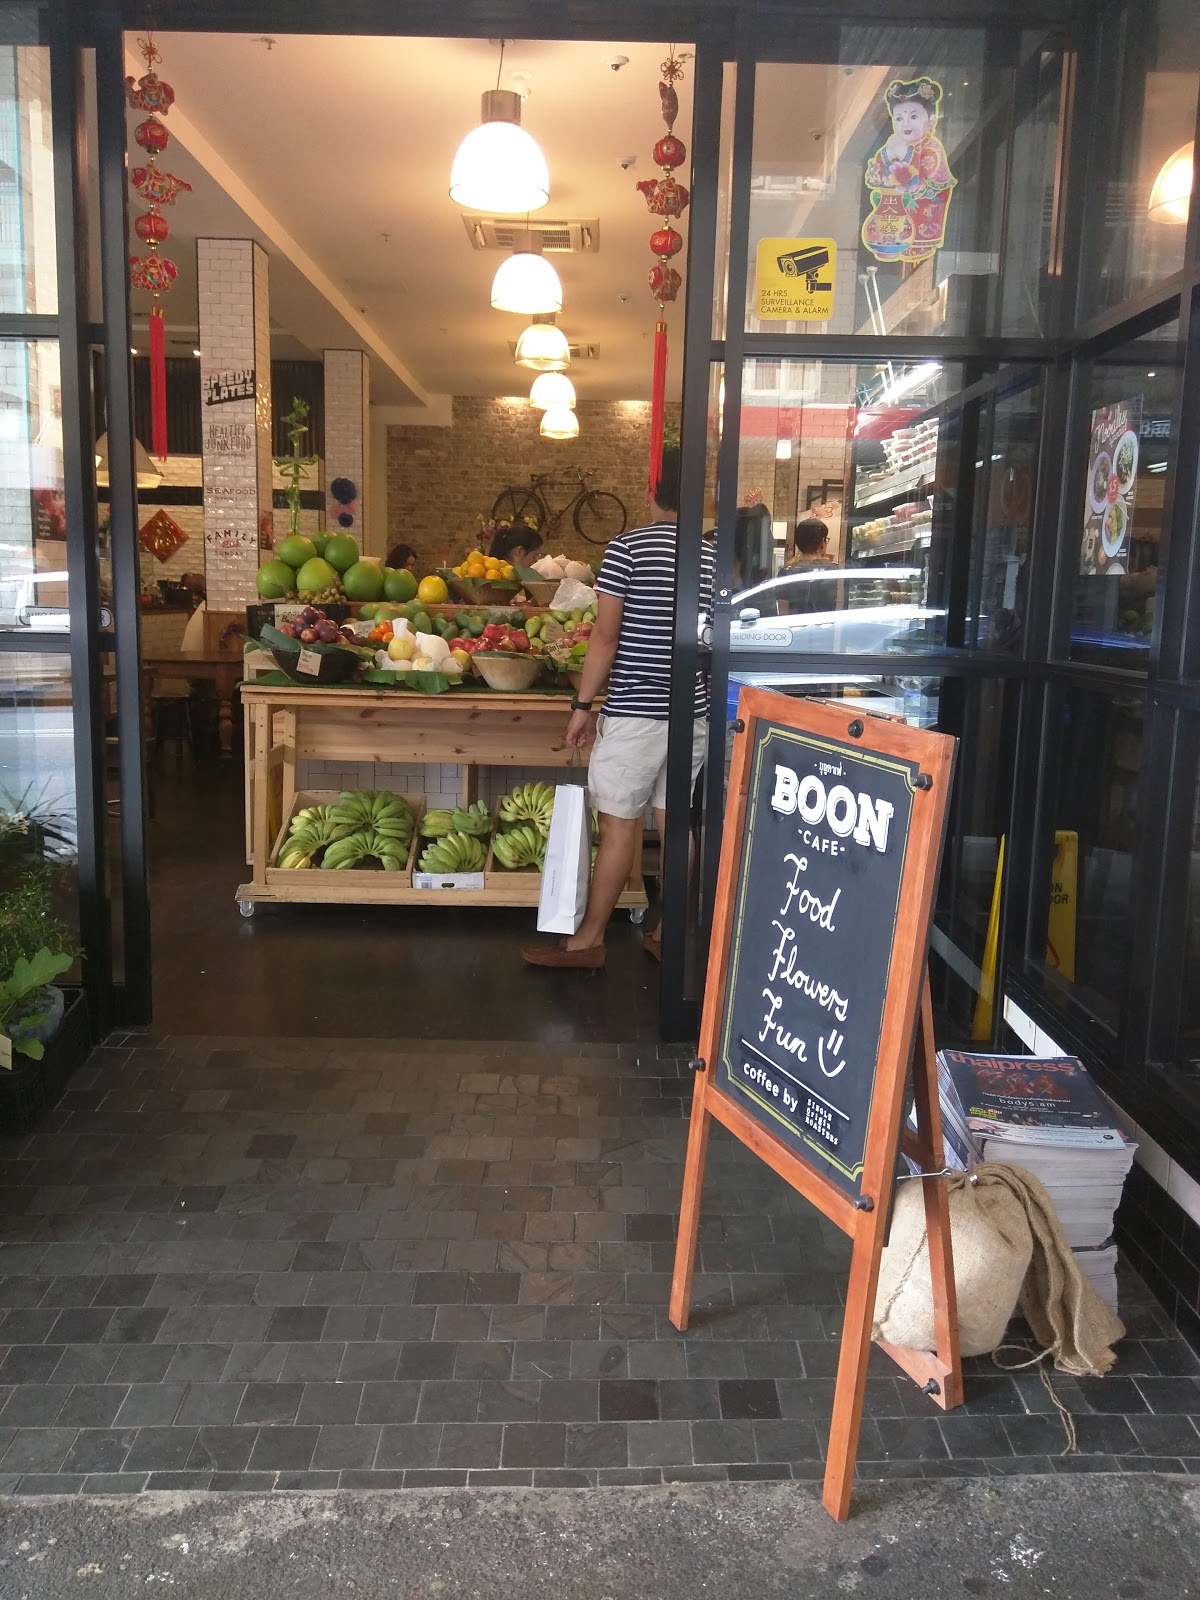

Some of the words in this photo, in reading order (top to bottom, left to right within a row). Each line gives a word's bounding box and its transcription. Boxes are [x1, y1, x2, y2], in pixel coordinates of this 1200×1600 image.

[202, 369, 254, 388] SPEEDY
[202, 382, 254, 402] PLATES
[209, 424, 247, 439] HEALTHY
[207, 487, 256, 495] SEAFOOD
[206, 529, 256, 544] FAMILY
[771, 764, 894, 853] BOON
[780, 853, 841, 932] Food
[767, 920, 849, 1022] Flowers
[758, 988, 808, 1063] Fun
[947, 1052, 1077, 1073] thaipress
[743, 1063, 780, 1097] coffee
[782, 1087, 798, 1113] by
[804, 1116, 839, 1145] ROASTERS
